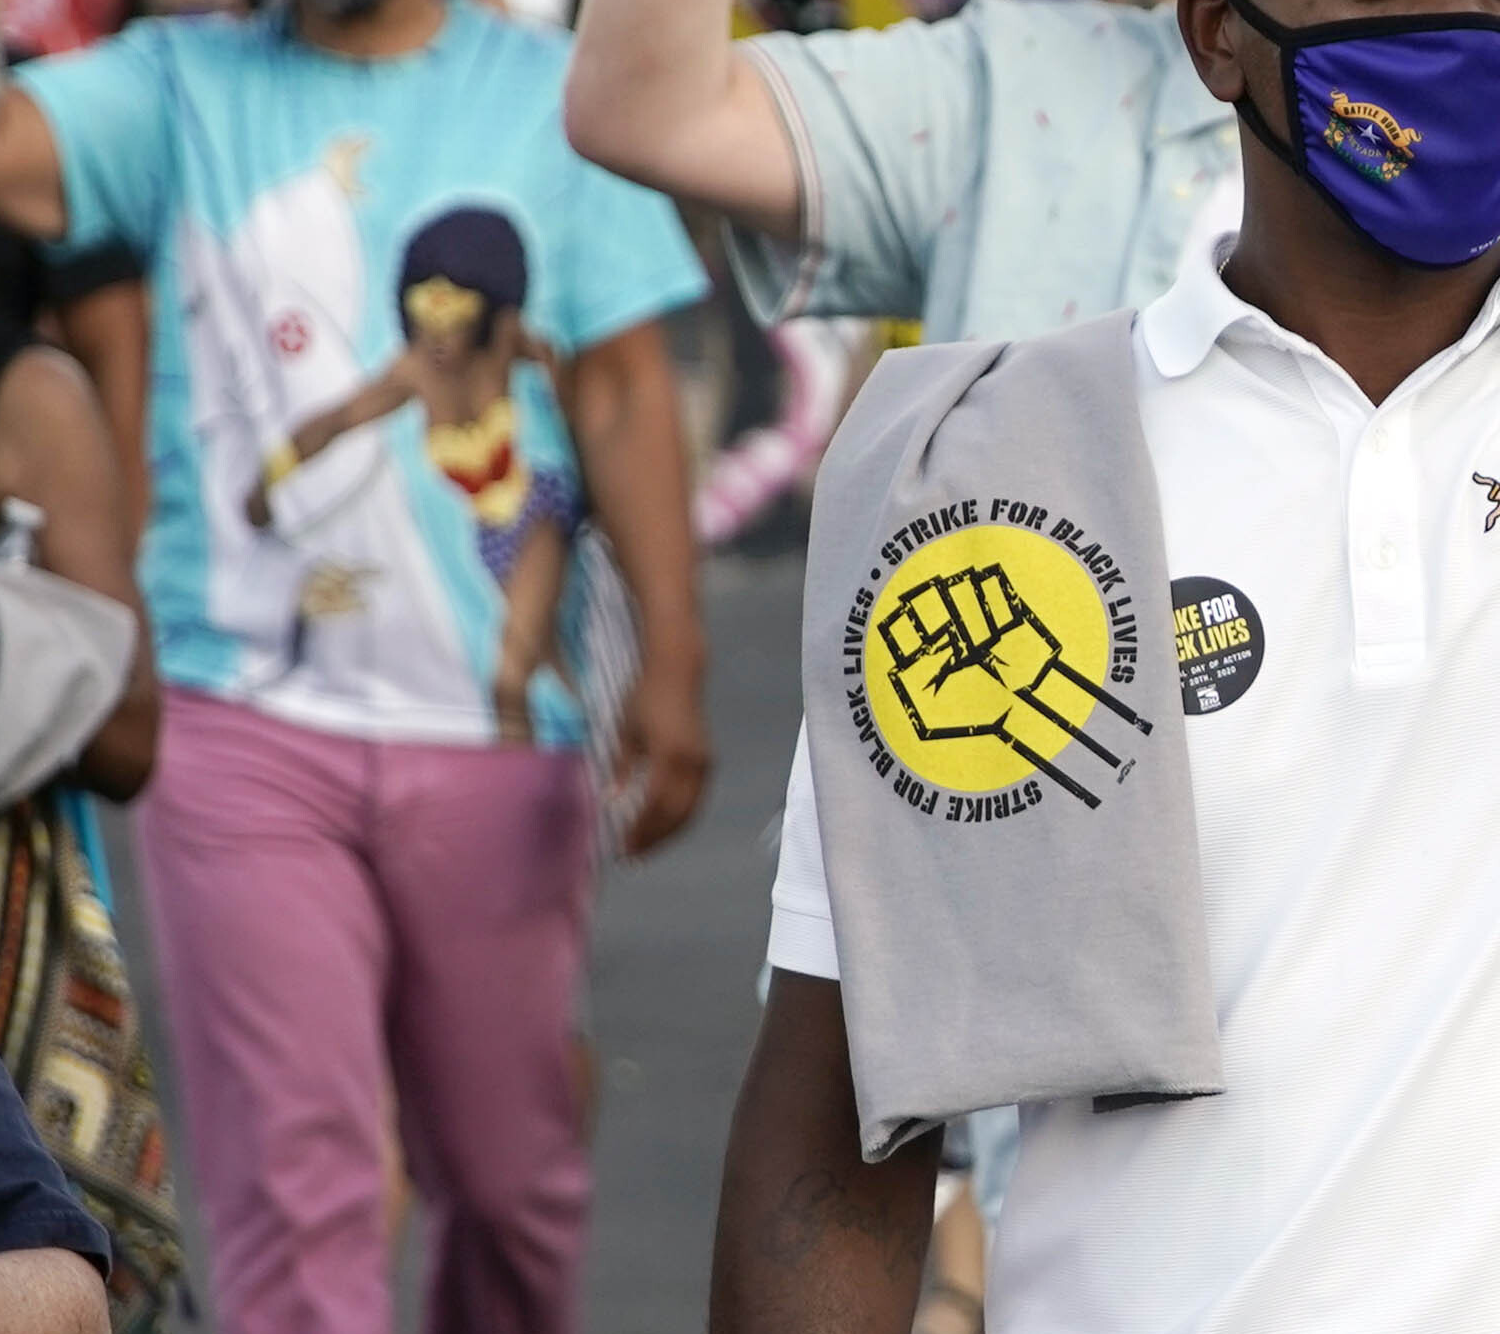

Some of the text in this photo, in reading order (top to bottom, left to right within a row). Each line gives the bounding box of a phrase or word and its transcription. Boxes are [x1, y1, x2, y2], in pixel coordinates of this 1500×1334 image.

[1343, 106, 1401, 141] BATTLE BORN
[880, 497, 1139, 685] STRIKE FOR BLACK LIVES
[1200, 593, 1240, 627] FOR
[1199, 618, 1251, 655] LIVES
[842, 586, 1044, 824] STRIKE FOR BLACK LIVES
